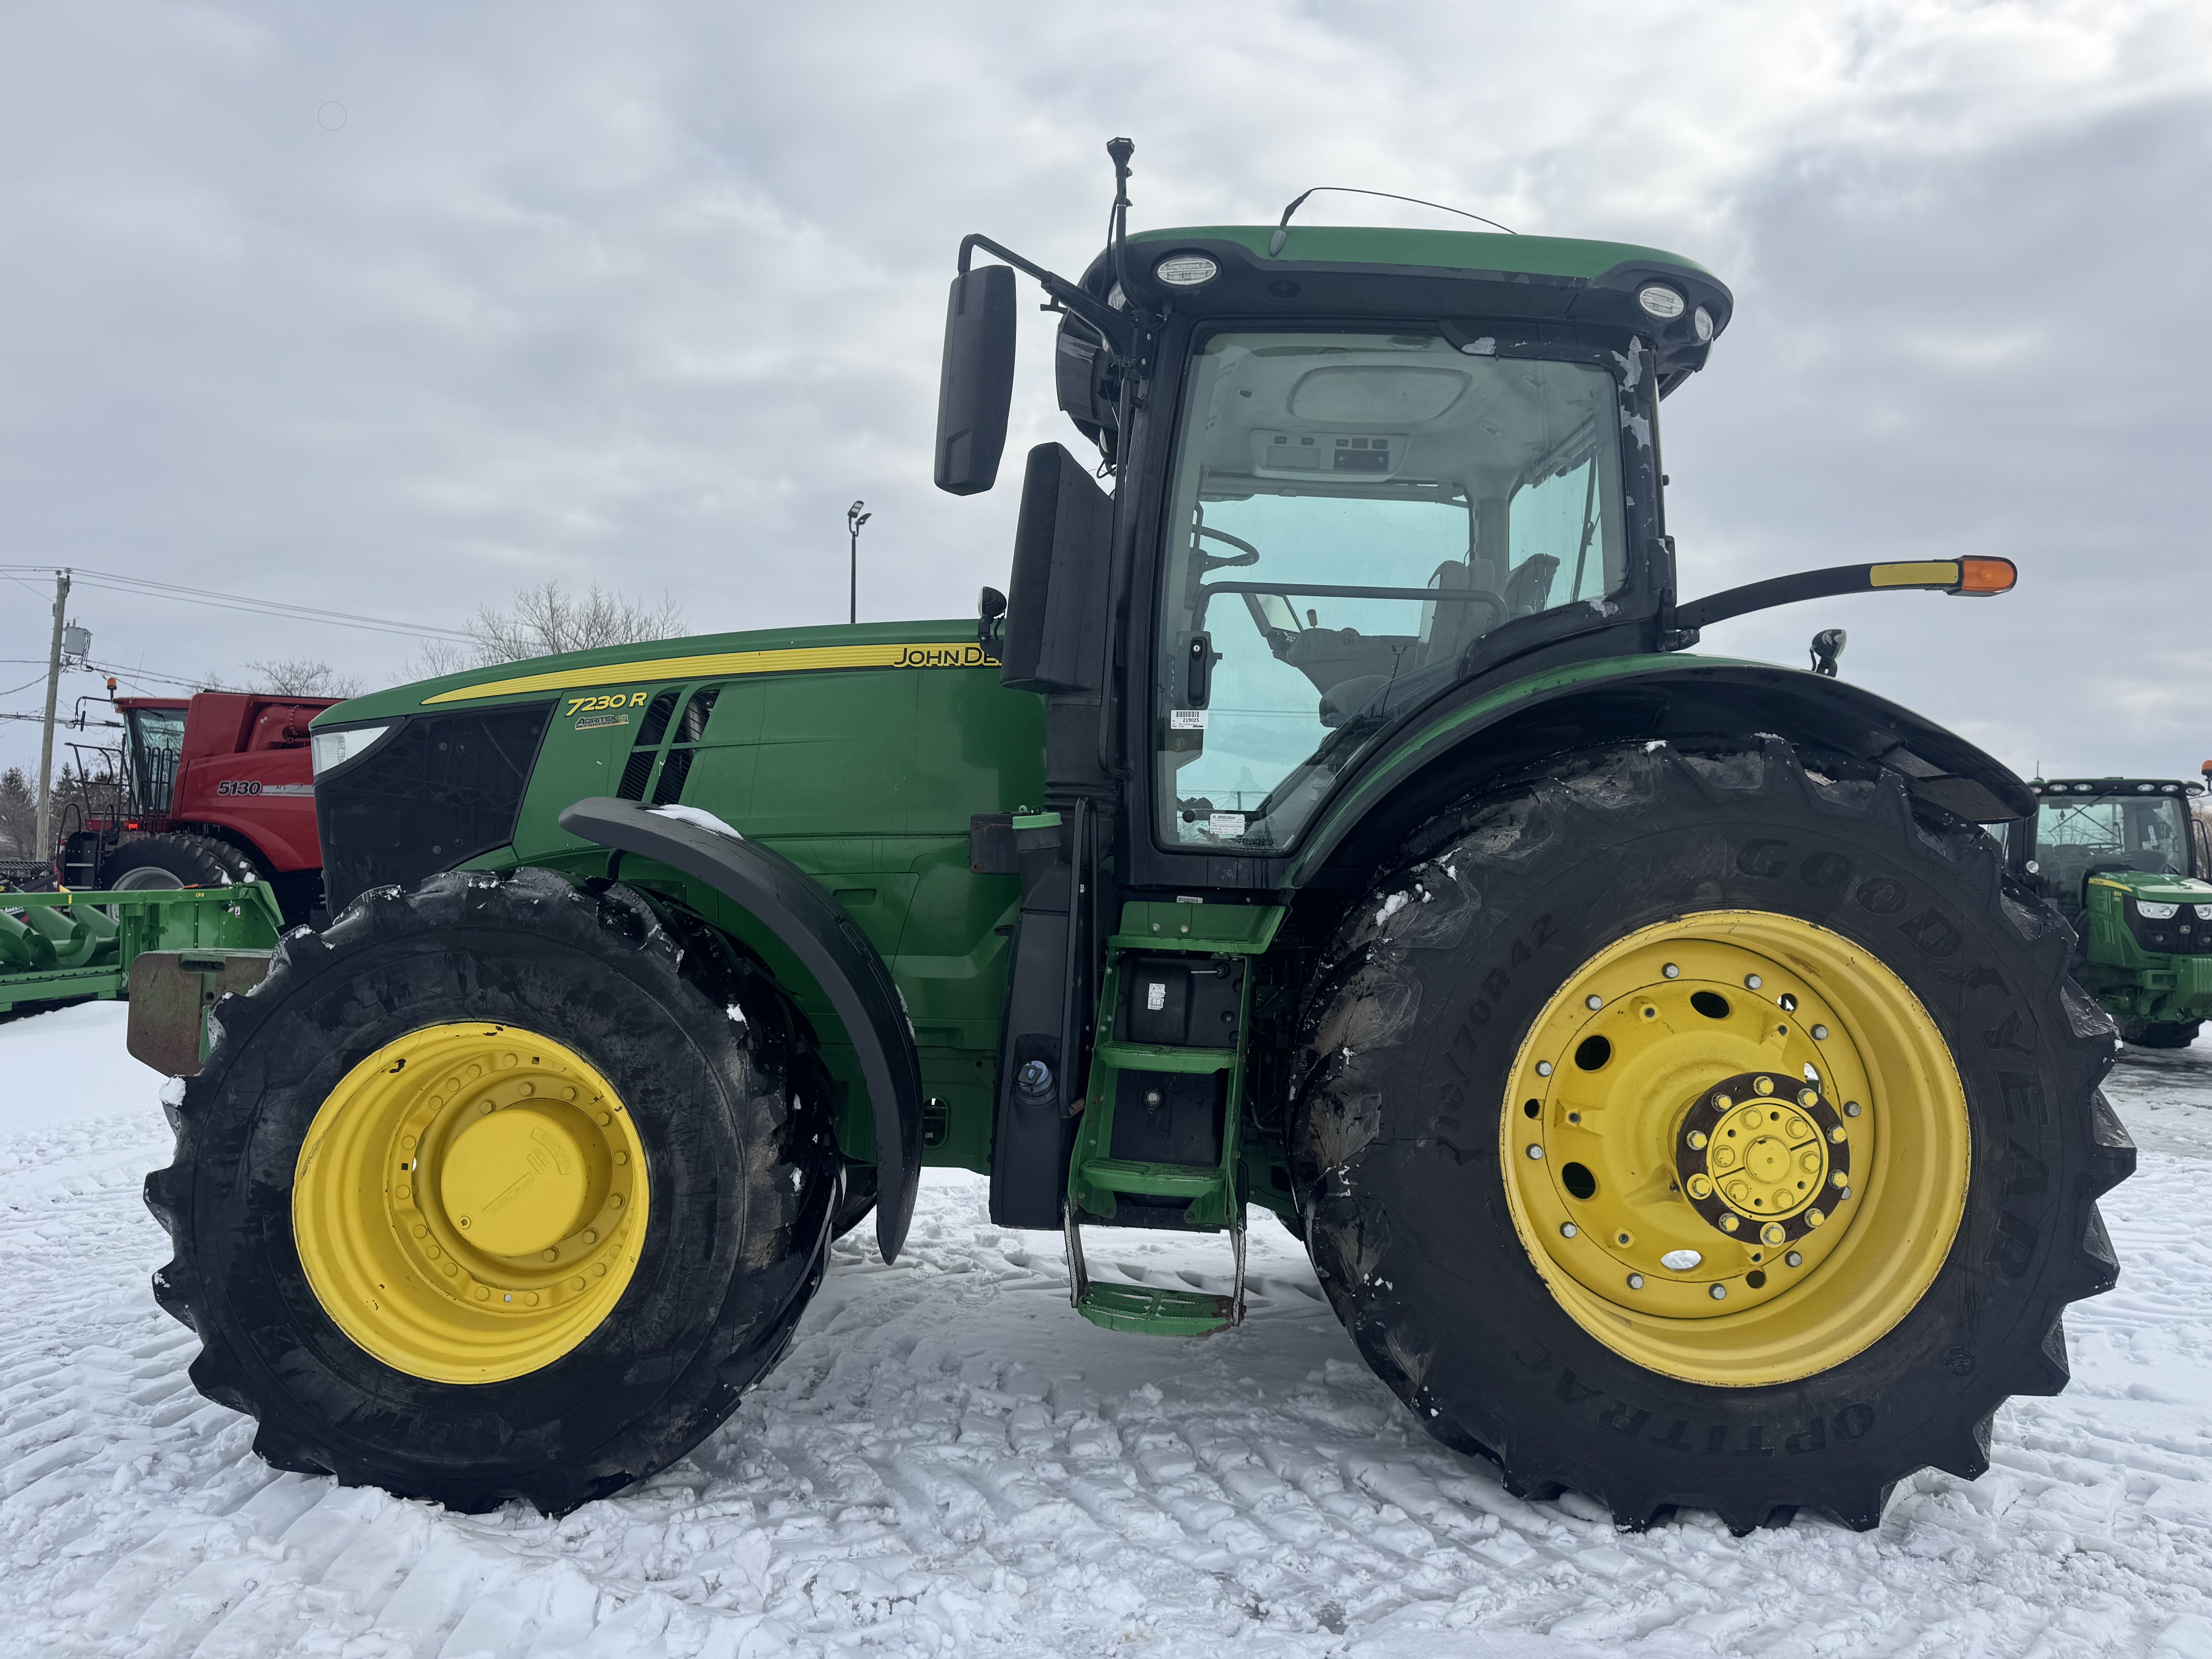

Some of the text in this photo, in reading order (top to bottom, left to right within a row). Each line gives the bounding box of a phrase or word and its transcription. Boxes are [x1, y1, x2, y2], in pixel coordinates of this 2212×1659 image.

[894, 647, 960, 666] JOHN
[565, 692, 648, 717] 7230 R
[576, 716, 616, 726] AGRITEX
[217, 780, 262, 796] 5130
[1435, 912, 1559, 1166] 710/70R42
[1736, 838, 2050, 1279] GOODYEAR
[1512, 1337, 1875, 1462] OPTITRAC
